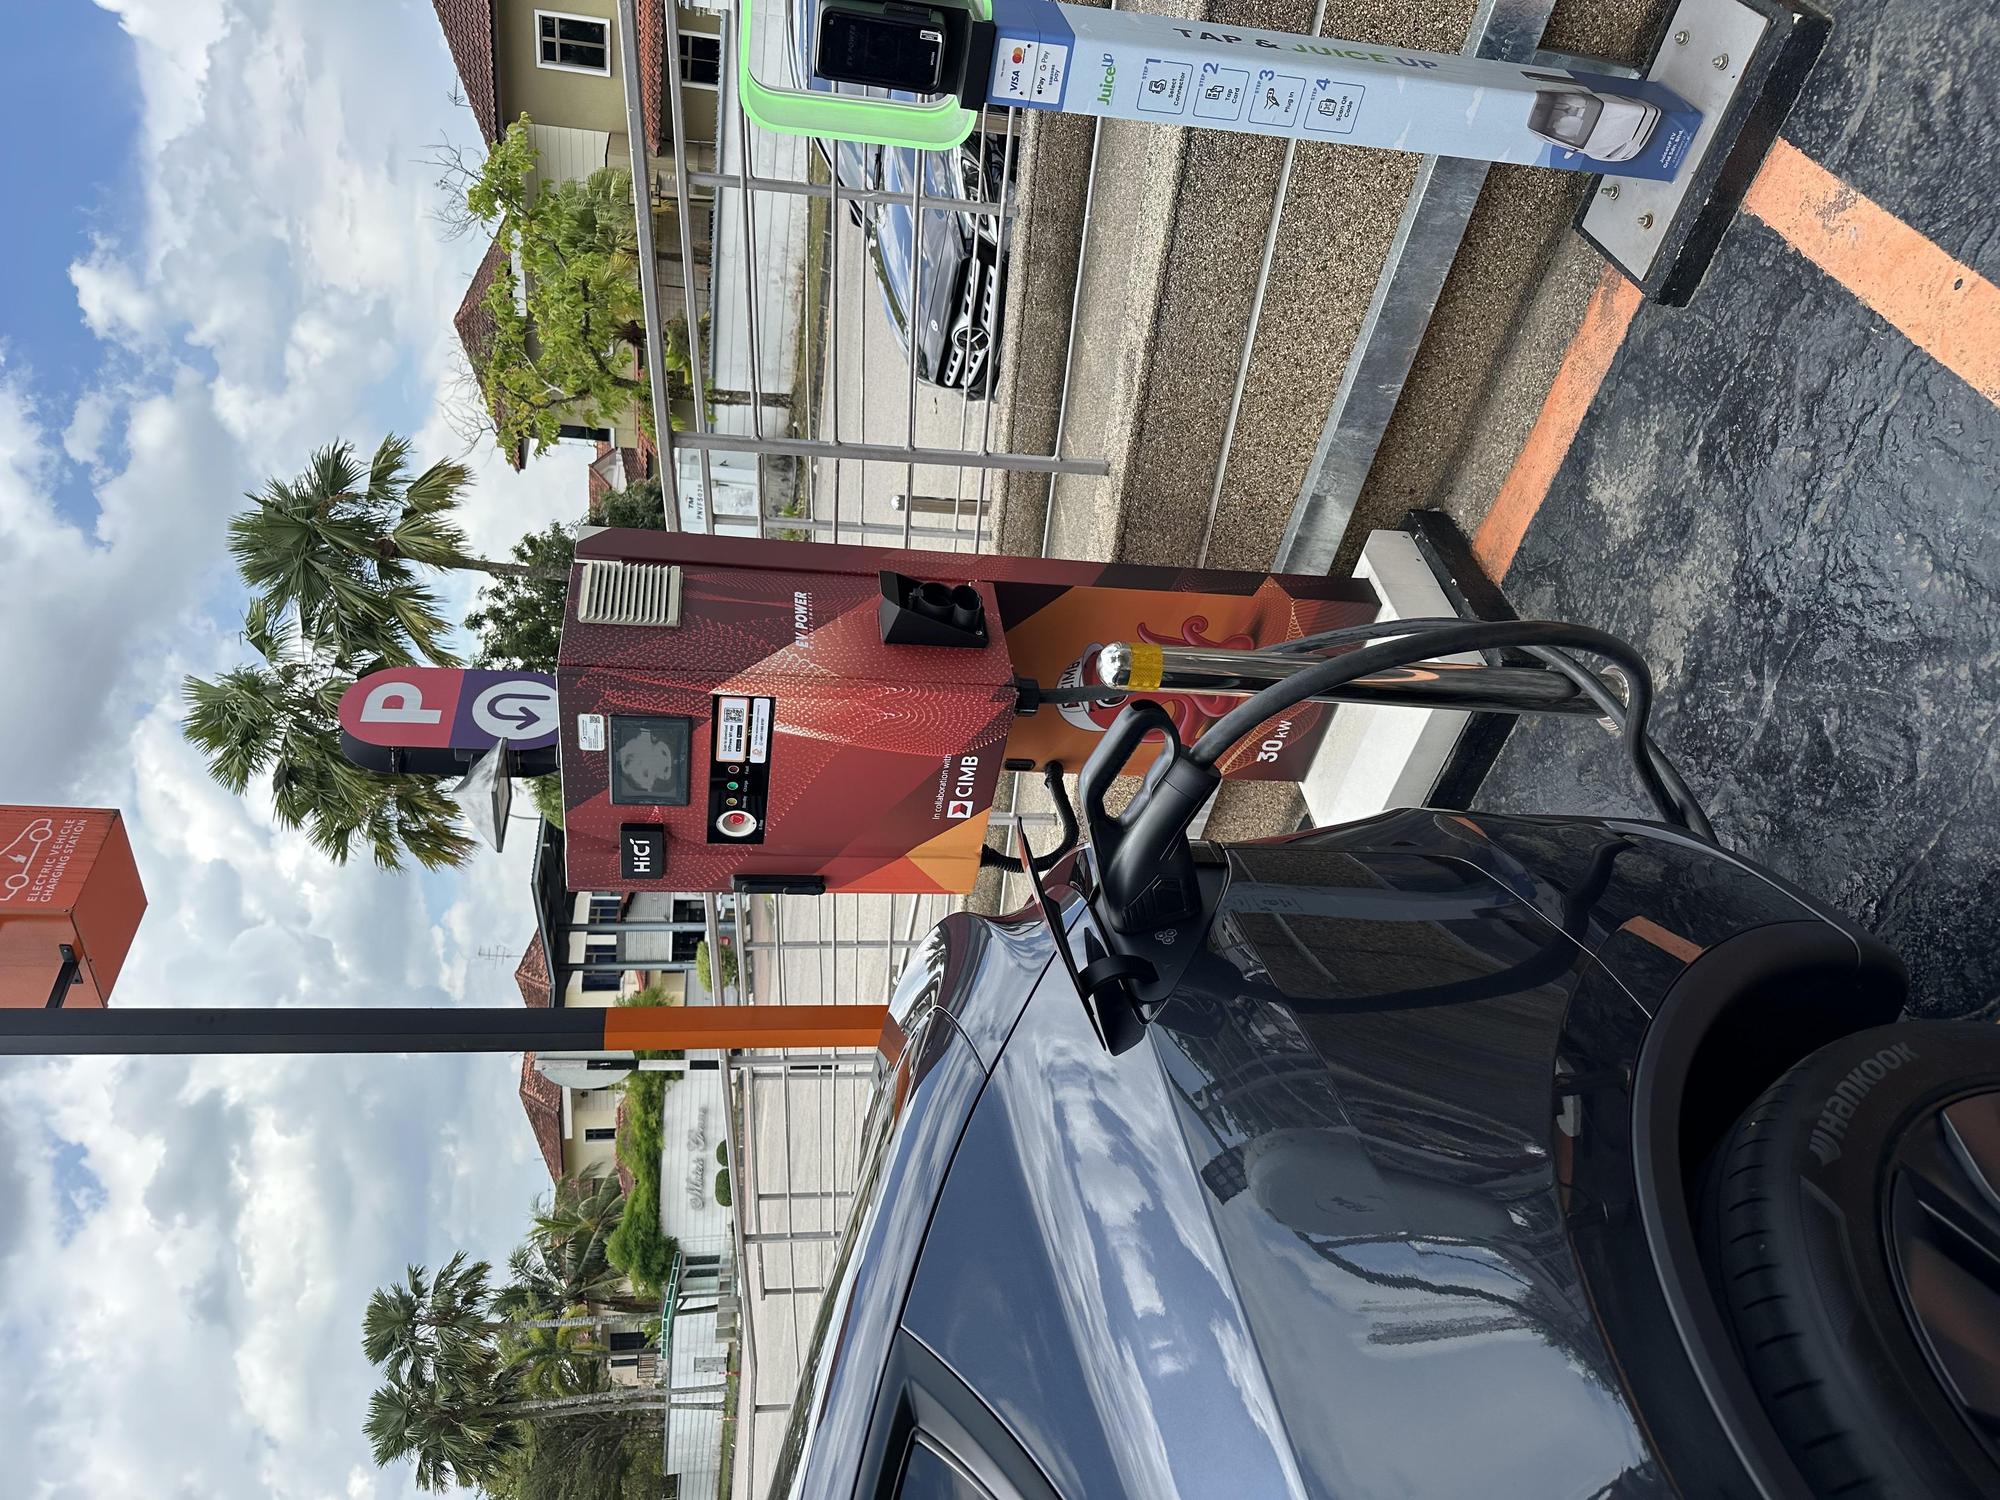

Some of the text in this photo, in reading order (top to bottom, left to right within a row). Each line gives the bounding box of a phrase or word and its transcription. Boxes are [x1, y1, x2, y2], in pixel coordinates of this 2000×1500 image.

[1041, 50, 1050, 63] Pay
[1172, 27, 1439, 70] TAP & JUICE UP
[1009, 70, 1020, 92] VISA
[1202, 62, 1219, 75] 2
[1036, 77, 1046, 89] Pay
[1167, 78, 1178, 99] Select
[1174, 71, 1186, 106] Connector
[1254, 69, 1275, 94] STEP 3
[1316, 78, 1331, 91] 4
[1224, 88, 1233, 102] Tap
[1232, 87, 1240, 104] Card
[1283, 98, 1294, 113] Plug
[1336, 95, 1348, 122] Scan QR
[1344, 100, 1353, 118] Code
[794, 592, 809, 648] EV POWER
[360, 682, 442, 724] P
[1256, 720, 1292, 763] 30 kW
[934, 770, 949, 812] collaboration
[942, 753, 952, 769] with
[955, 756, 979, 798] CIMB
[26, 818, 76, 902] ELECTRIC VEHICLE
[40, 818, 88, 902] CHARGING STATION
